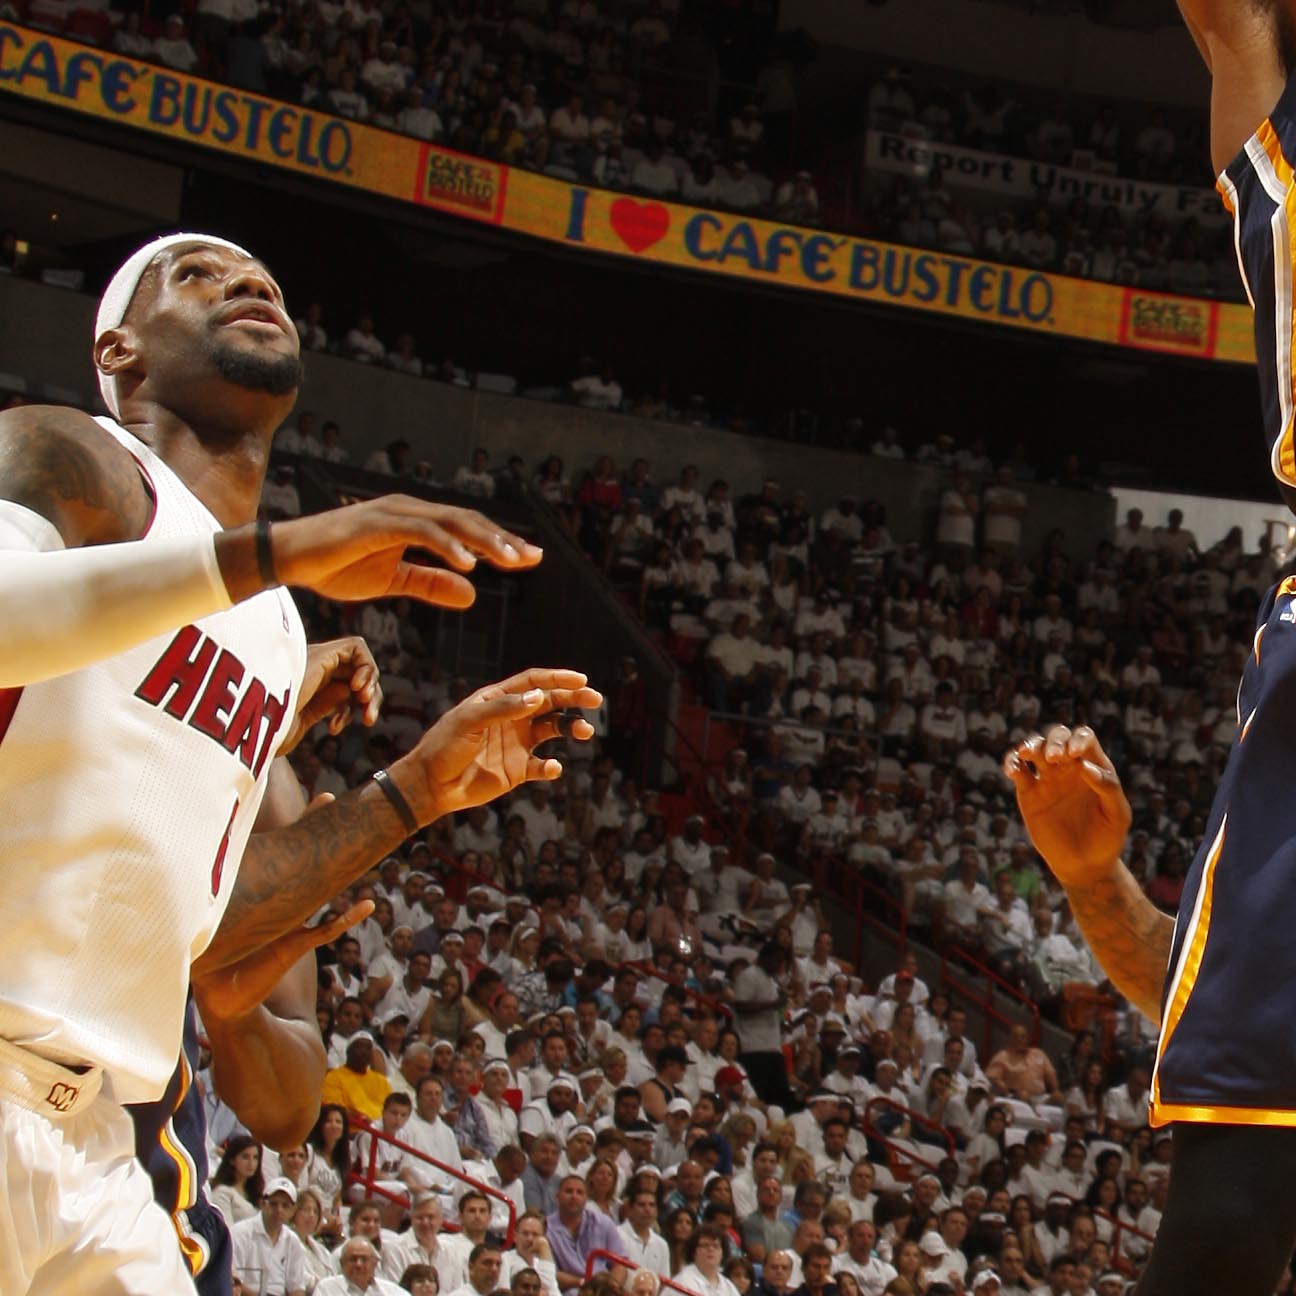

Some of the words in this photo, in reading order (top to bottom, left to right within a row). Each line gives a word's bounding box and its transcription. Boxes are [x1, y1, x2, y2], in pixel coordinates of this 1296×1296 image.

[148, 73, 352, 173] BUSTELO
[879, 133, 1014, 184] Report
[1030, 161, 1160, 215] Unruly
[849, 245, 1055, 324] BUSTELO
[133, 624, 291, 782] HEAT
